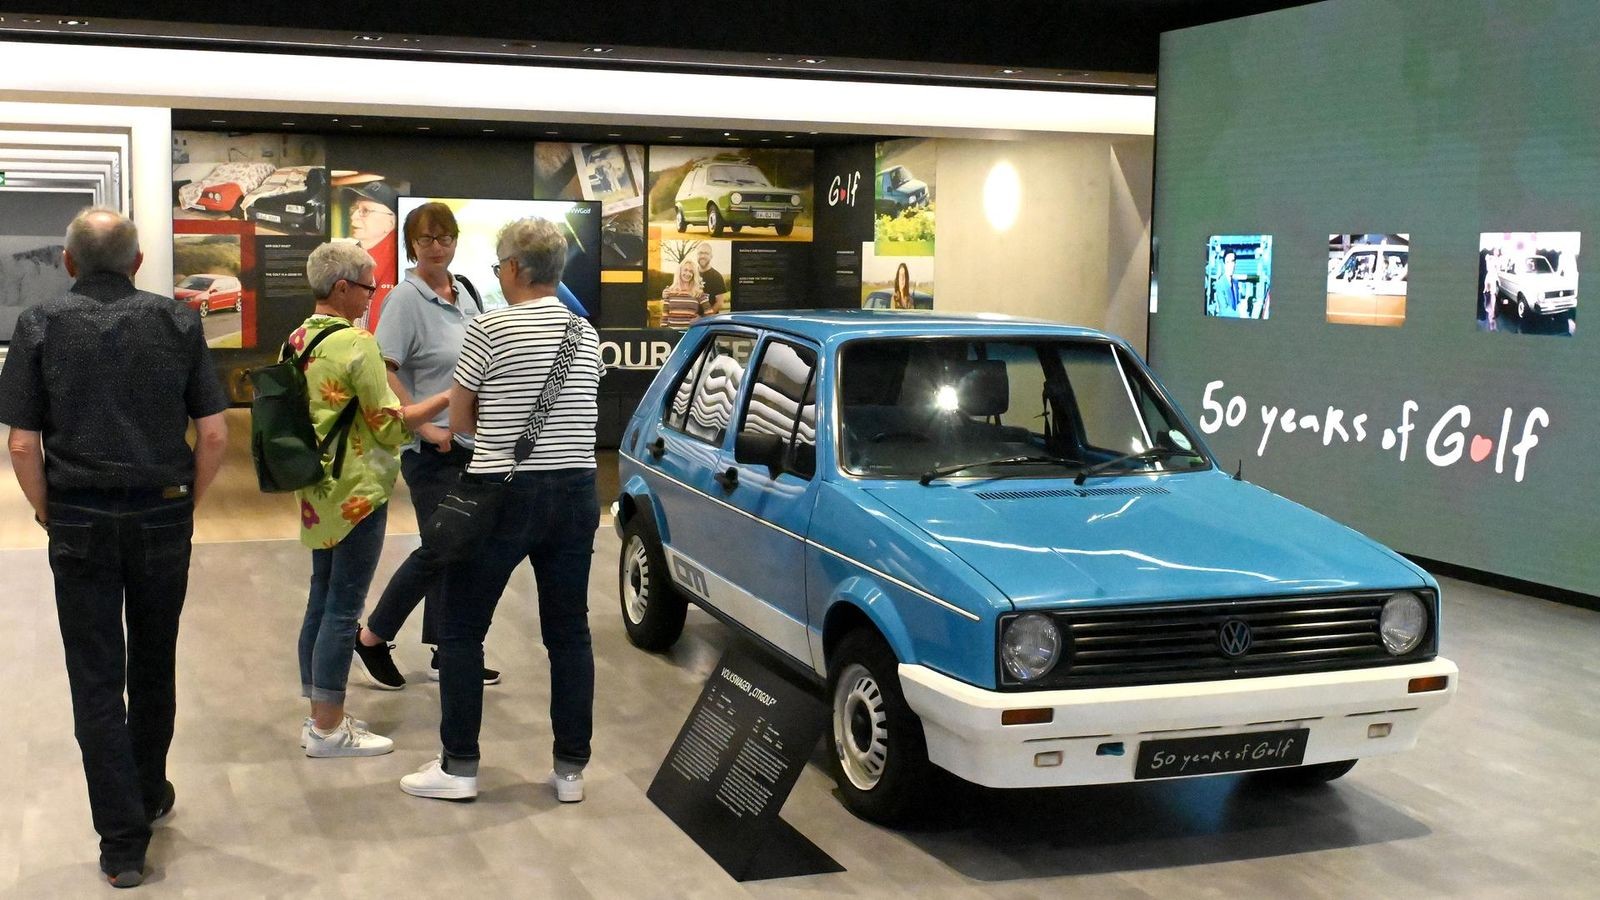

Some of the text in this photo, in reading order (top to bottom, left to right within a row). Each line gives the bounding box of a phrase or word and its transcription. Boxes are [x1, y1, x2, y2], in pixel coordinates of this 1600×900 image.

[828, 170, 861, 208] Golf
[1199, 380, 1247, 434] 50
[1381, 400, 1419, 462] of
[1426, 404, 1550, 483] Golf
[721, 667, 752, 693] VOLKSWAGEN
[1151, 751, 1176, 770] 50
[1235, 744, 1251, 761] of
[1251, 738, 1294, 760] Golf
